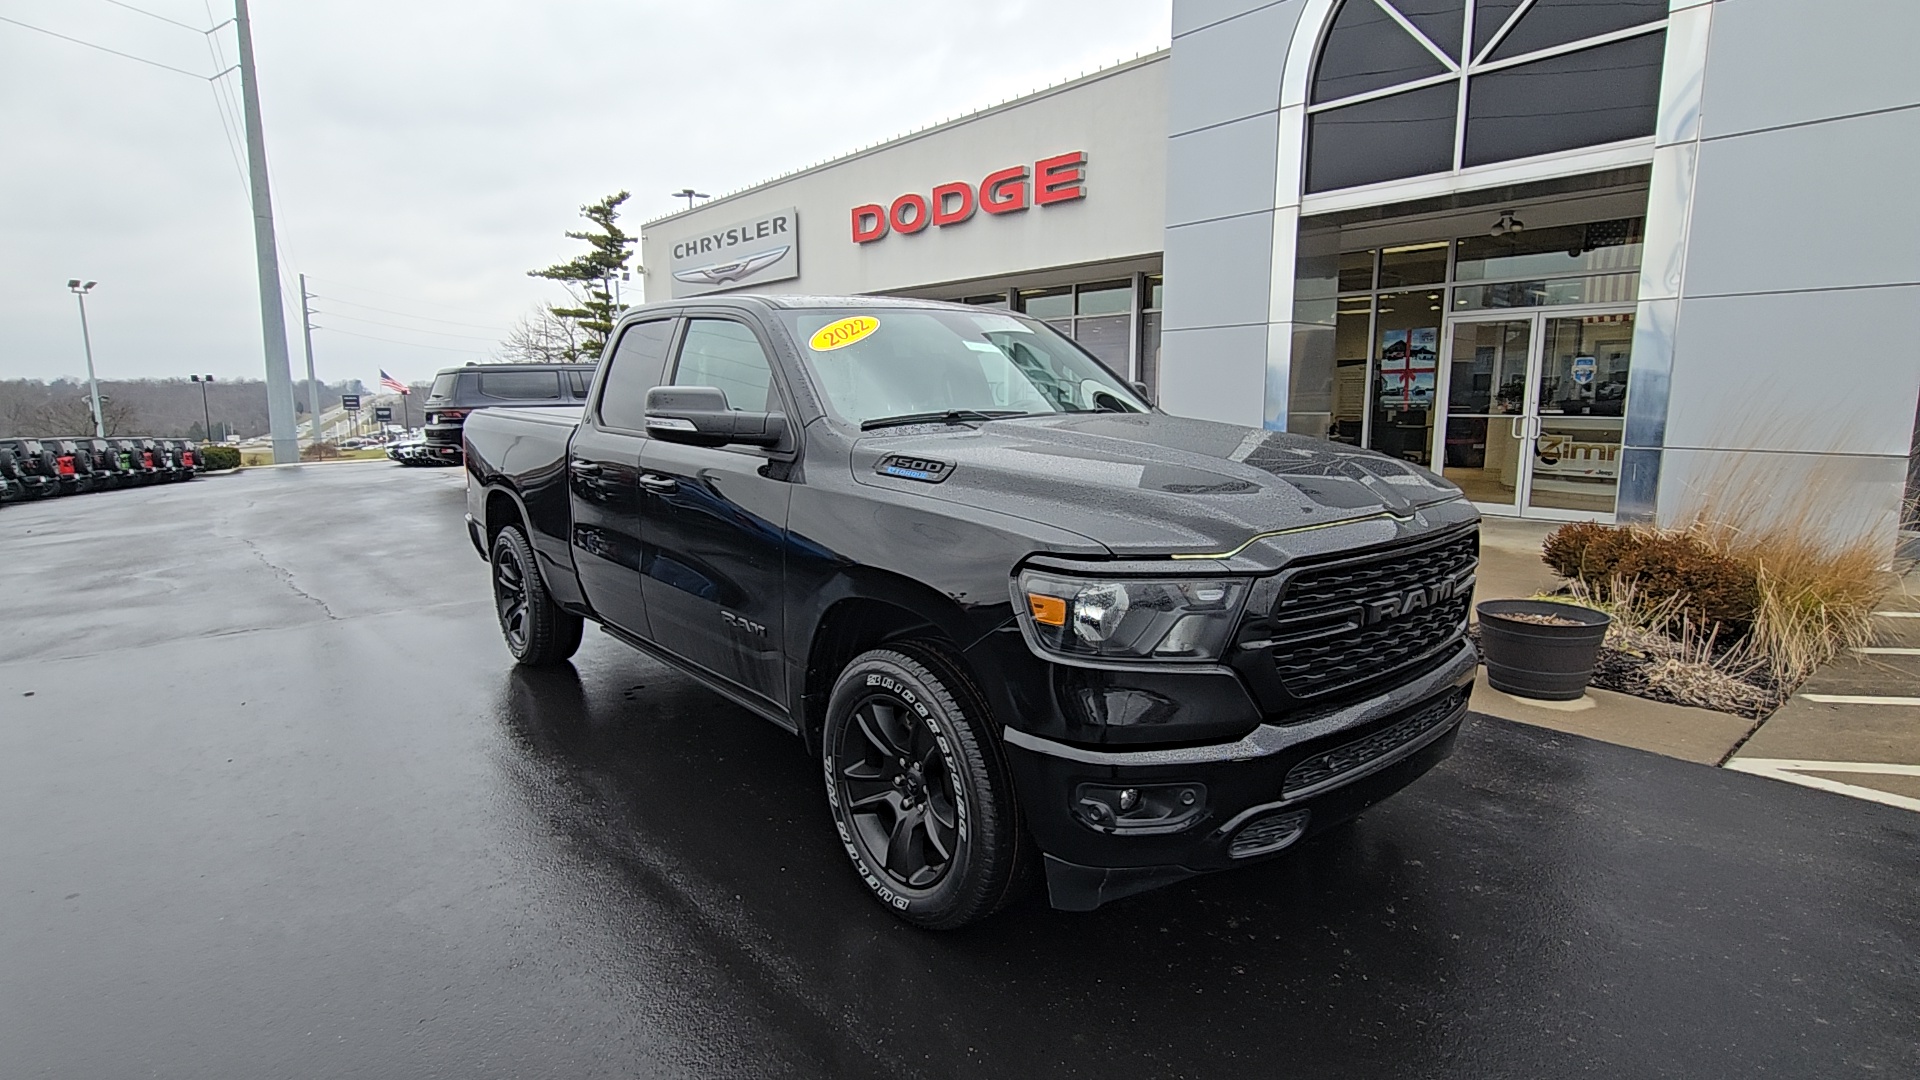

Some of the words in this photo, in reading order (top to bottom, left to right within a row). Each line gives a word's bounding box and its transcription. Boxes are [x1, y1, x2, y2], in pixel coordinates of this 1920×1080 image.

[851, 151, 1087, 245] DODGE
[673, 216, 788, 260] CHRYSLER
[823, 319, 870, 346] 2022
[886, 457, 942, 471] 1500
[1366, 579, 1455, 625] RAM
[720, 610, 767, 639] RAM
[866, 674, 967, 842] BRIDGESTONE
